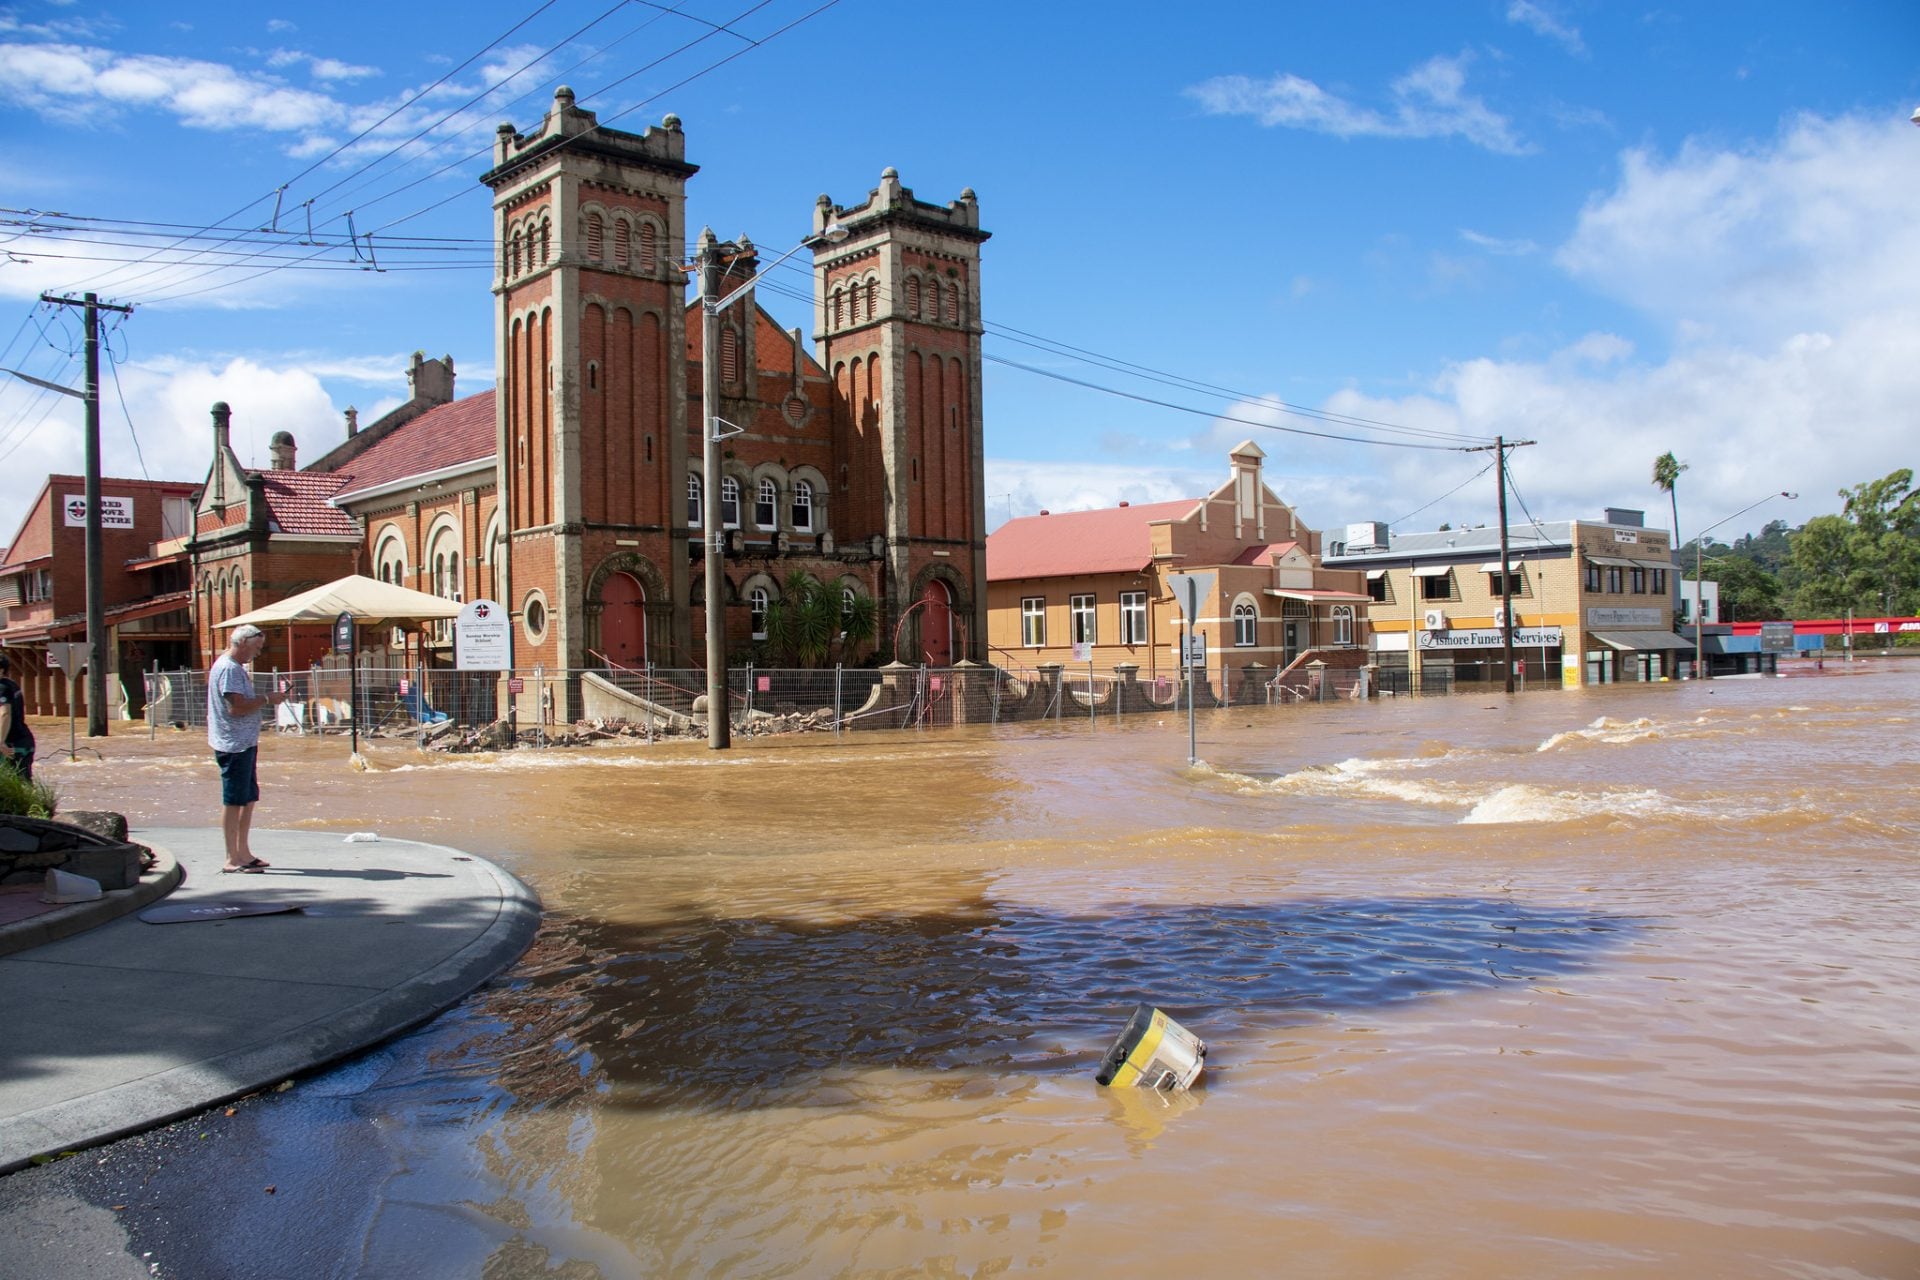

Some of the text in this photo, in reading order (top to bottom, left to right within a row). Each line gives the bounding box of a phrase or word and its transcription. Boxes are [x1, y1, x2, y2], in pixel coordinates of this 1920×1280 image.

[1420, 631, 1558, 648] Lismore Funera Services
